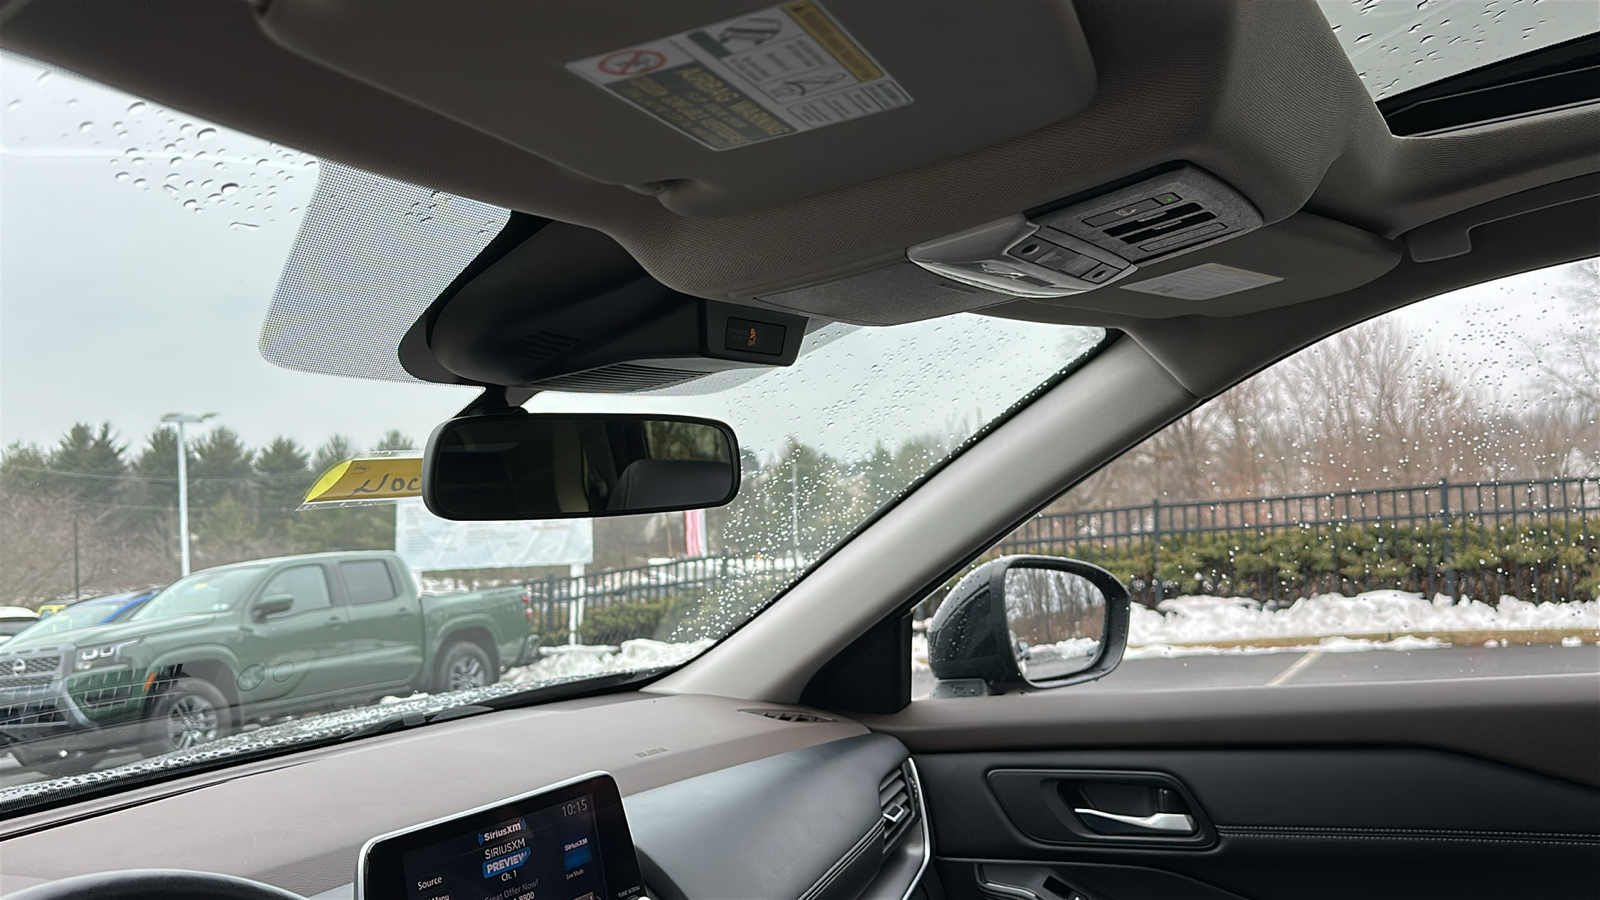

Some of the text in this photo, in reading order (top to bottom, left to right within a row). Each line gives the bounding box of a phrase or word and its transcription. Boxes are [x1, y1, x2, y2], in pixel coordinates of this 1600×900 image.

[562, 799, 588, 817] 10:15
[484, 837, 526, 860] SIRIUSXM
[486, 851, 527, 874] PREVIEW
[513, 869, 517, 878] 1
[417, 876, 443, 891] Source
[503, 886, 521, 898] Offer
